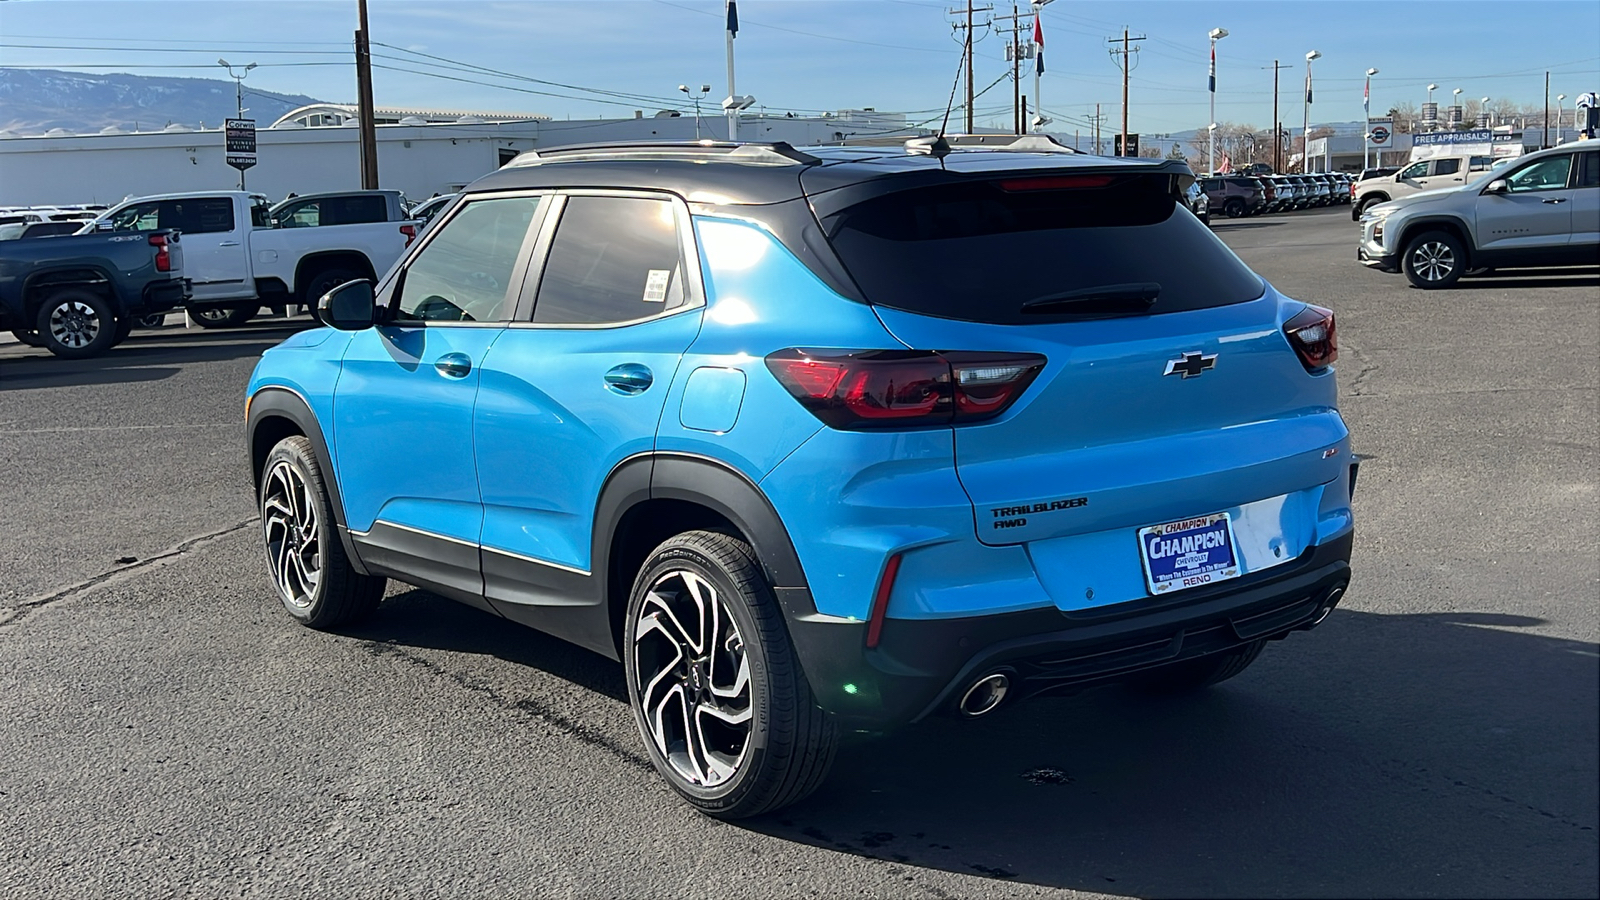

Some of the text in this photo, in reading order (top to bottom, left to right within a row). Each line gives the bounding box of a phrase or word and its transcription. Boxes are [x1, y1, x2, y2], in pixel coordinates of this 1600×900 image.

[229, 121, 255, 129] Corwin
[1415, 135, 1436, 144] FREE
[1437, 132, 1489, 143] APPRAISALS!
[991, 497, 1088, 517] TRAILBLAZER
[993, 518, 1027, 529] AWD
[1165, 518, 1207, 533] CHAMPION
[1150, 530, 1225, 559] CHAMPION
[1177, 554, 1207, 565] CHEVROLET
[1183, 574, 1211, 587] RENO
